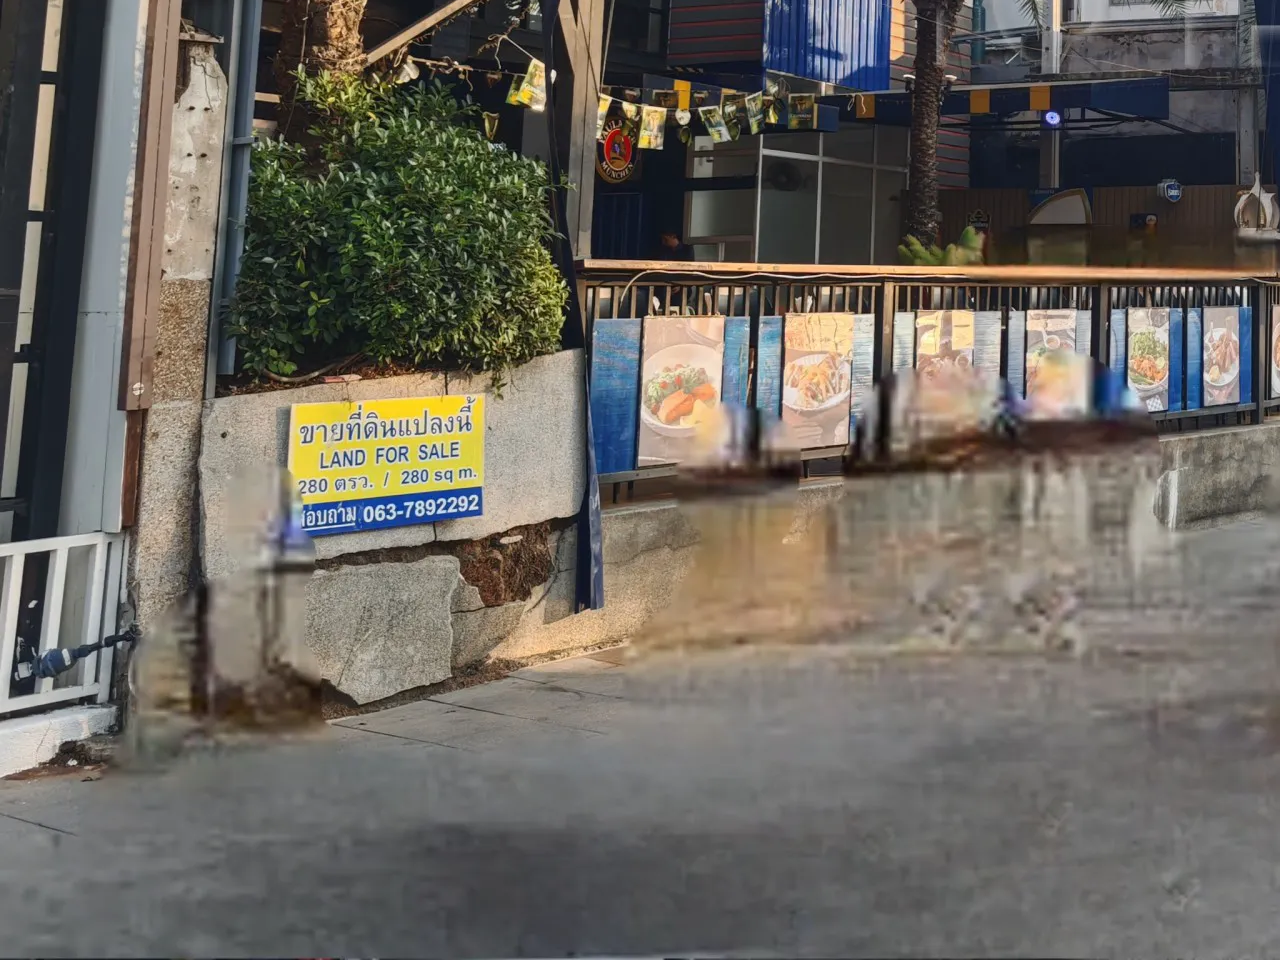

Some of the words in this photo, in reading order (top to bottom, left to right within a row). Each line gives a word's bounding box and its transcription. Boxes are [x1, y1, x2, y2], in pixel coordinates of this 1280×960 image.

[299, 396, 476, 444] ขายที่ดินแปลงนี้
[320, 449, 366, 469] LAND
[376, 446, 410, 464] FOR
[418, 442, 460, 461] SALE
[299, 478, 328, 494] 280
[334, 474, 374, 491] ตรว.
[401, 469, 429, 485] 280
[434, 470, 453, 483] sq
[458, 467, 478, 480] m.
[363, 495, 479, 523] 063-7892292
